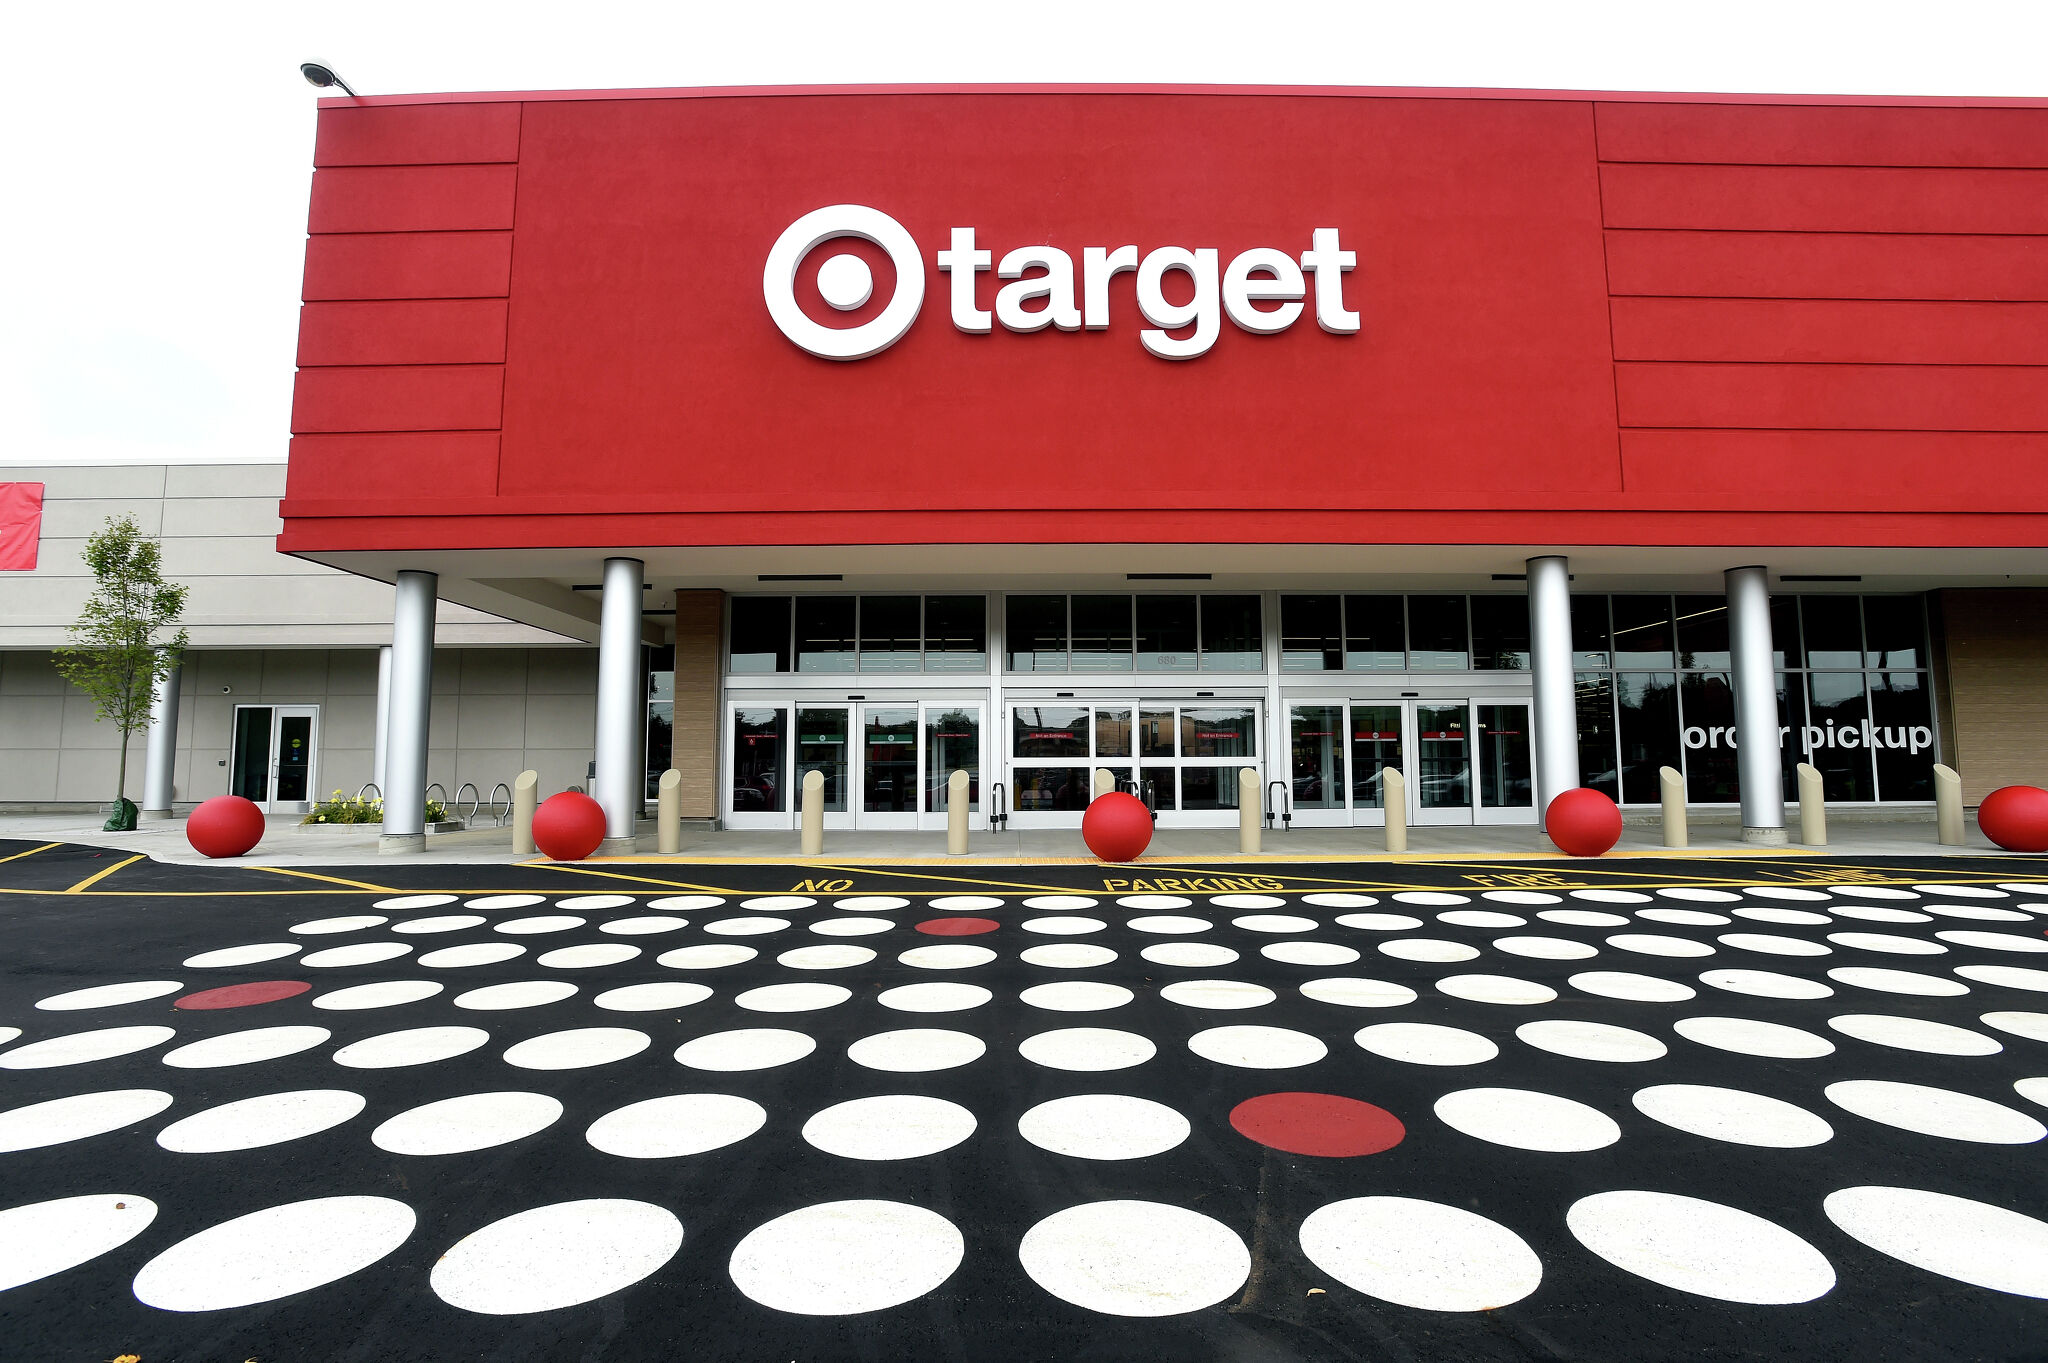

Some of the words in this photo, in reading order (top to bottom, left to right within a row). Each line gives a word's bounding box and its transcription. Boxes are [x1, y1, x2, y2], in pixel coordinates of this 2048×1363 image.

[937, 226, 1361, 361] target
[1157, 655, 1177, 665] 680
[1683, 726, 1791, 749] orr
[1801, 718, 1933, 755] pickup
[790, 879, 855, 892] NO
[1102, 877, 1285, 891] PARKING
[1460, 873, 1589, 887] FIRE
